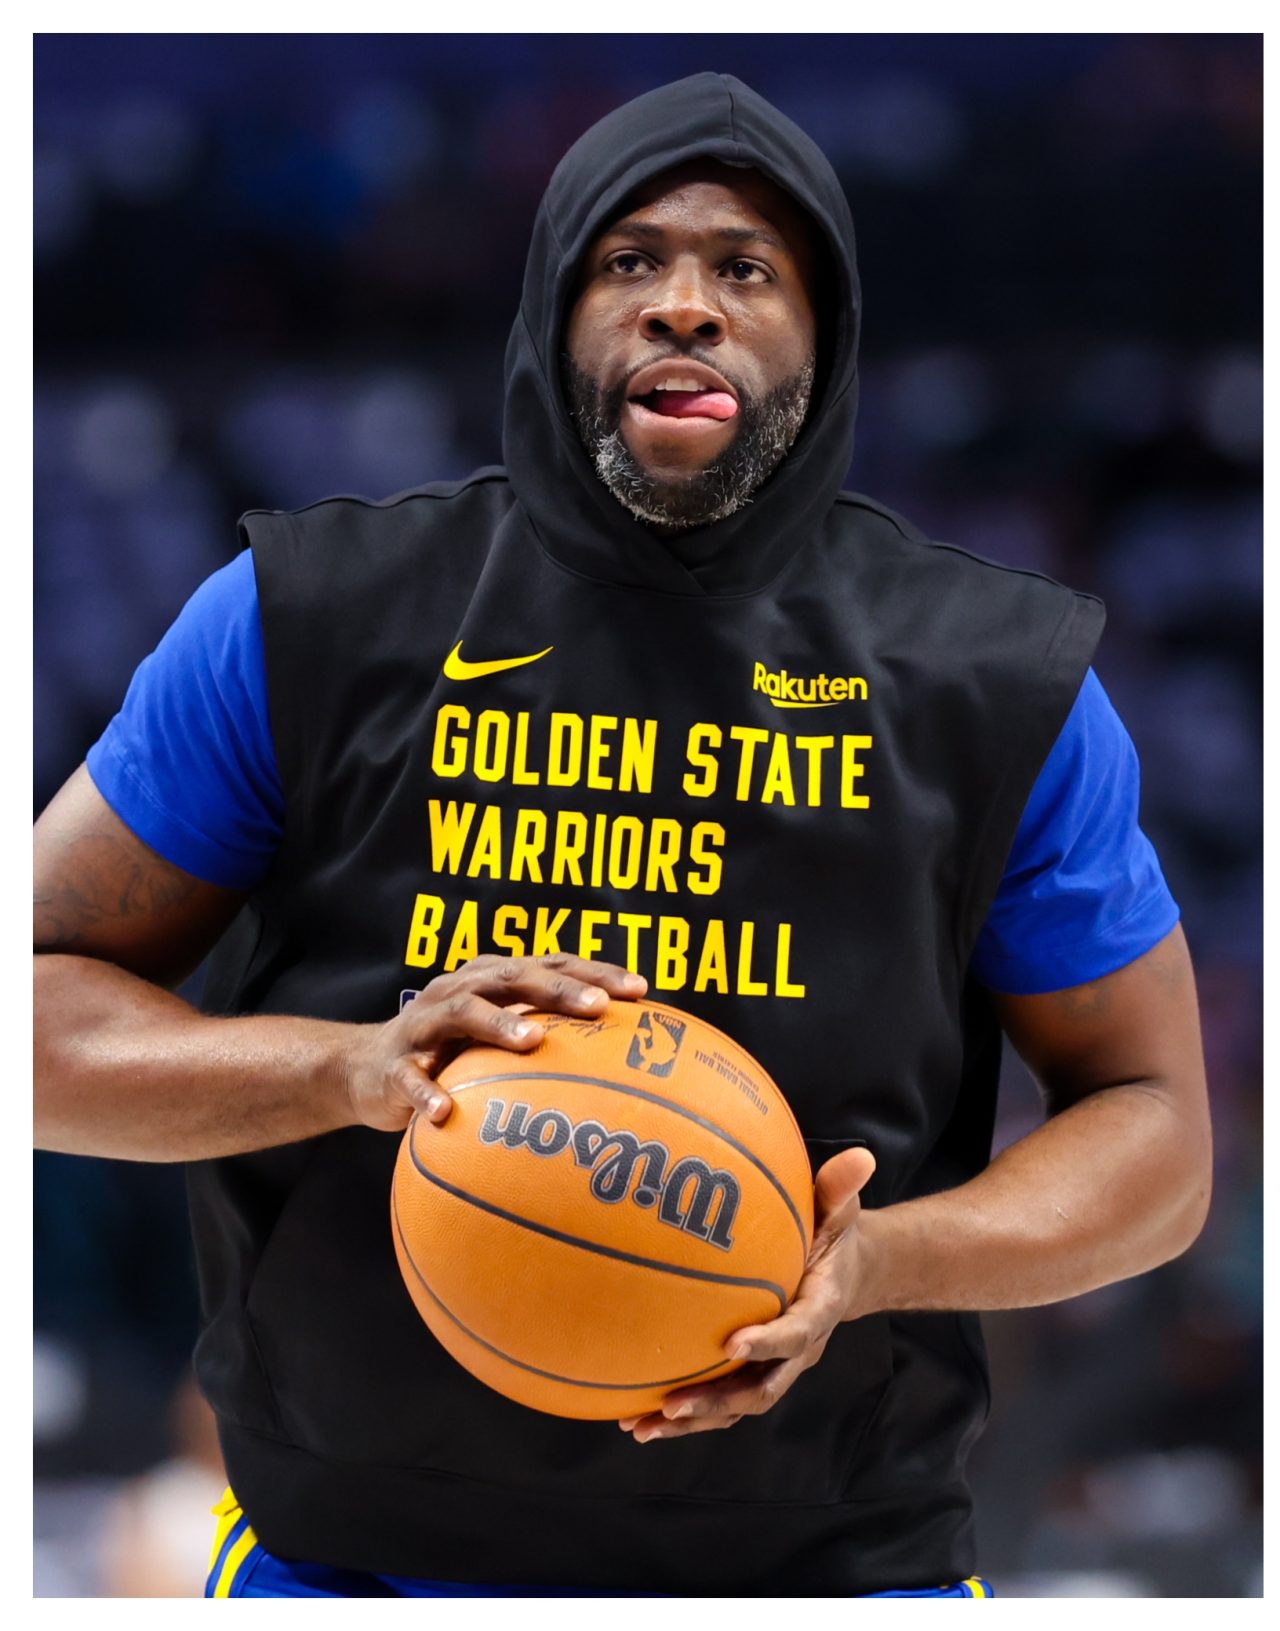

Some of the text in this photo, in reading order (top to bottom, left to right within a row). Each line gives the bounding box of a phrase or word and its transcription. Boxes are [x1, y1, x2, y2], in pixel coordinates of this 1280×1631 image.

[752, 661, 868, 704] Rakuten
[431, 704, 873, 809] GOLDEN STATE
[428, 799, 726, 896] WARRIORS
[405, 893, 806, 998] BASKETBALL
[480, 1097, 741, 1252] Wilson
